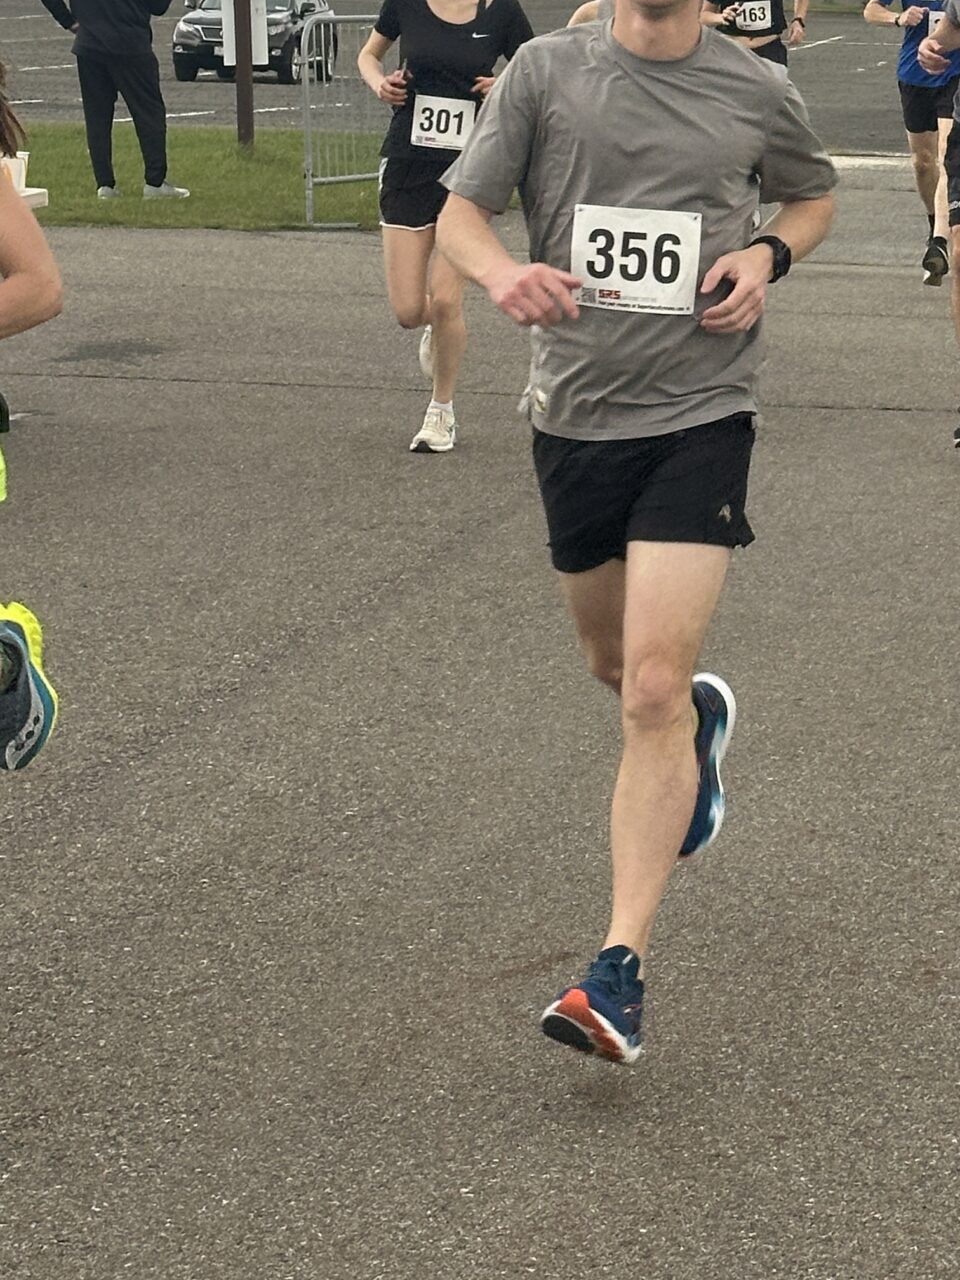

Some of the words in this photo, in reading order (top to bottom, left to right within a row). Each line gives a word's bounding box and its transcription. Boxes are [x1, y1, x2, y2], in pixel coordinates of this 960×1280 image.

[741, 7, 766, 23] 163
[419, 107, 464, 136] 301
[586, 228, 681, 284] 356
